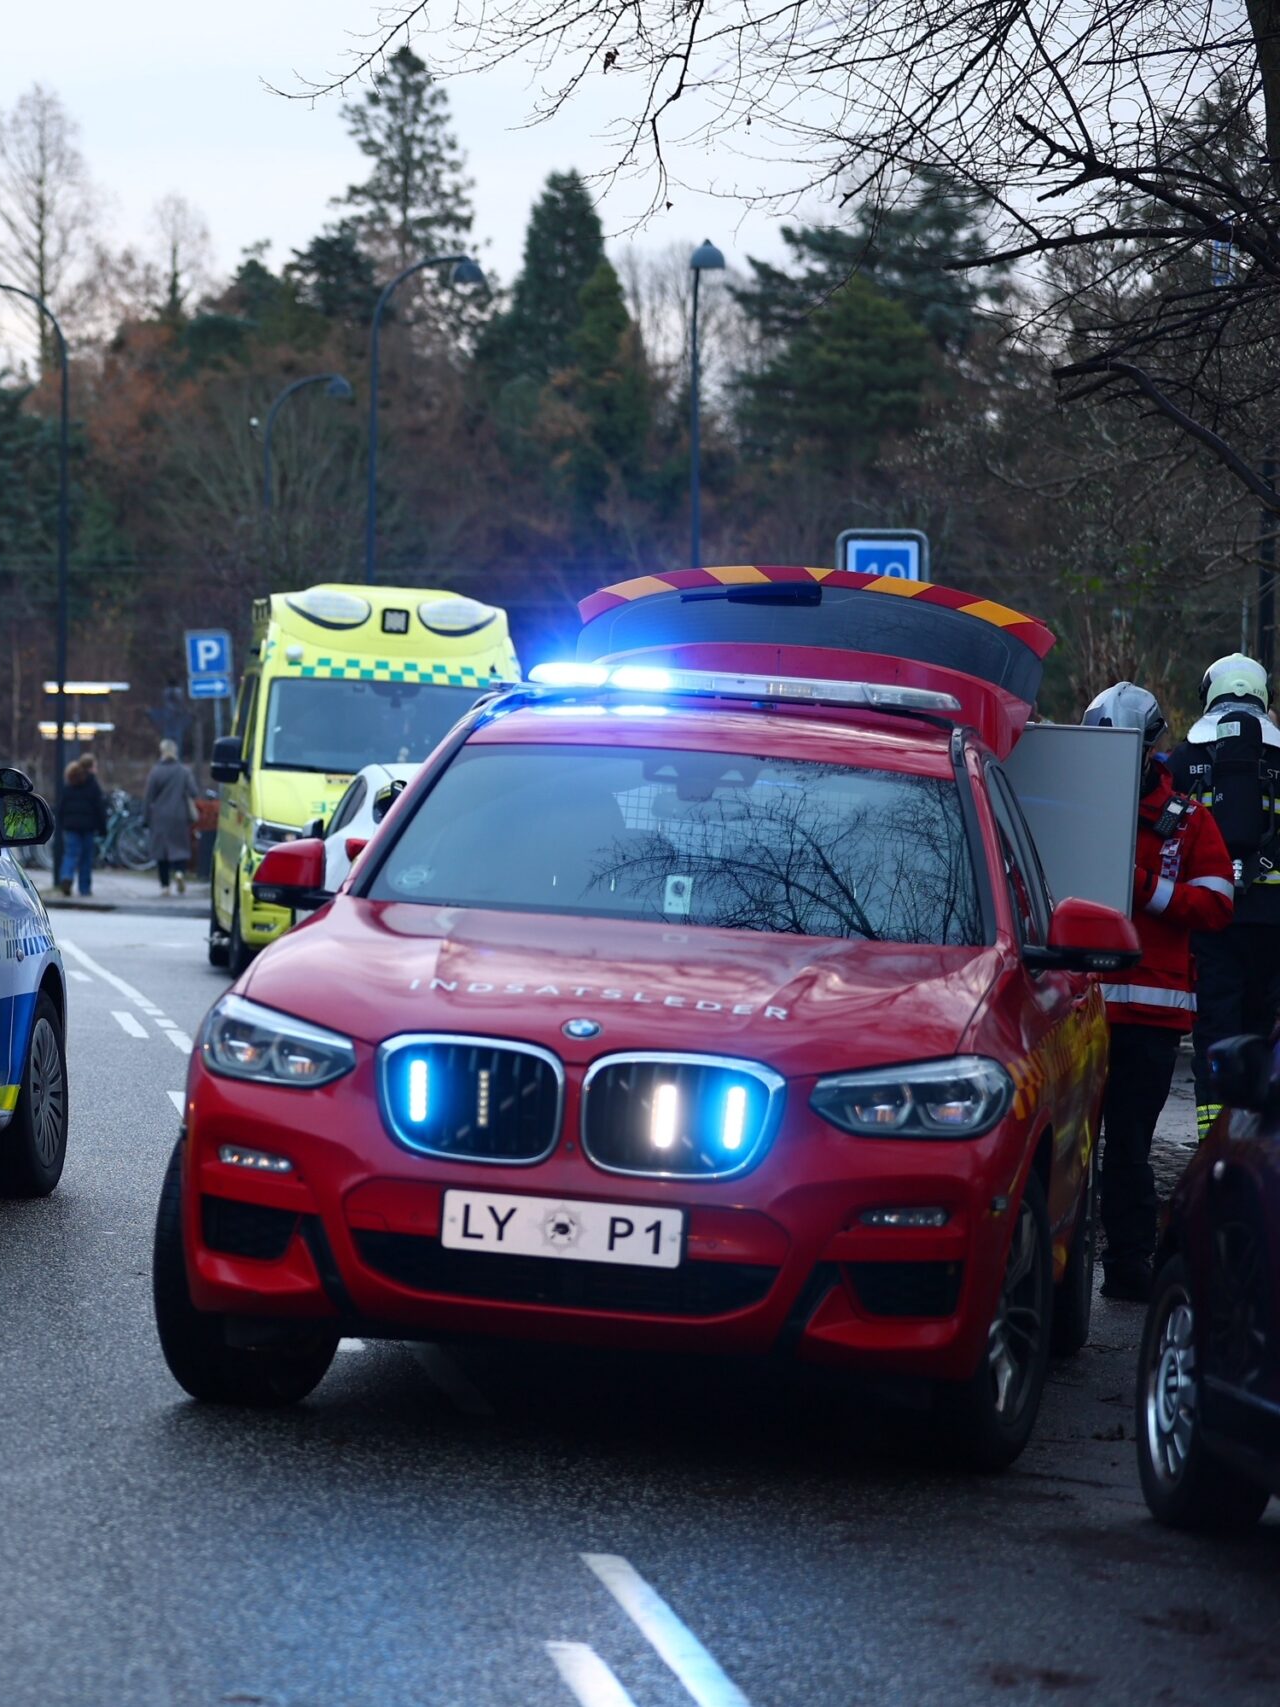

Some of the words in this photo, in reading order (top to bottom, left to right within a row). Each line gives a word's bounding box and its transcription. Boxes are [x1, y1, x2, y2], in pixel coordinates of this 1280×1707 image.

[197, 640, 220, 670] P
[410, 978, 789, 1021] INDSATSLEDER
[462, 1204, 517, 1241] LY
[608, 1216, 662, 1255] P1
